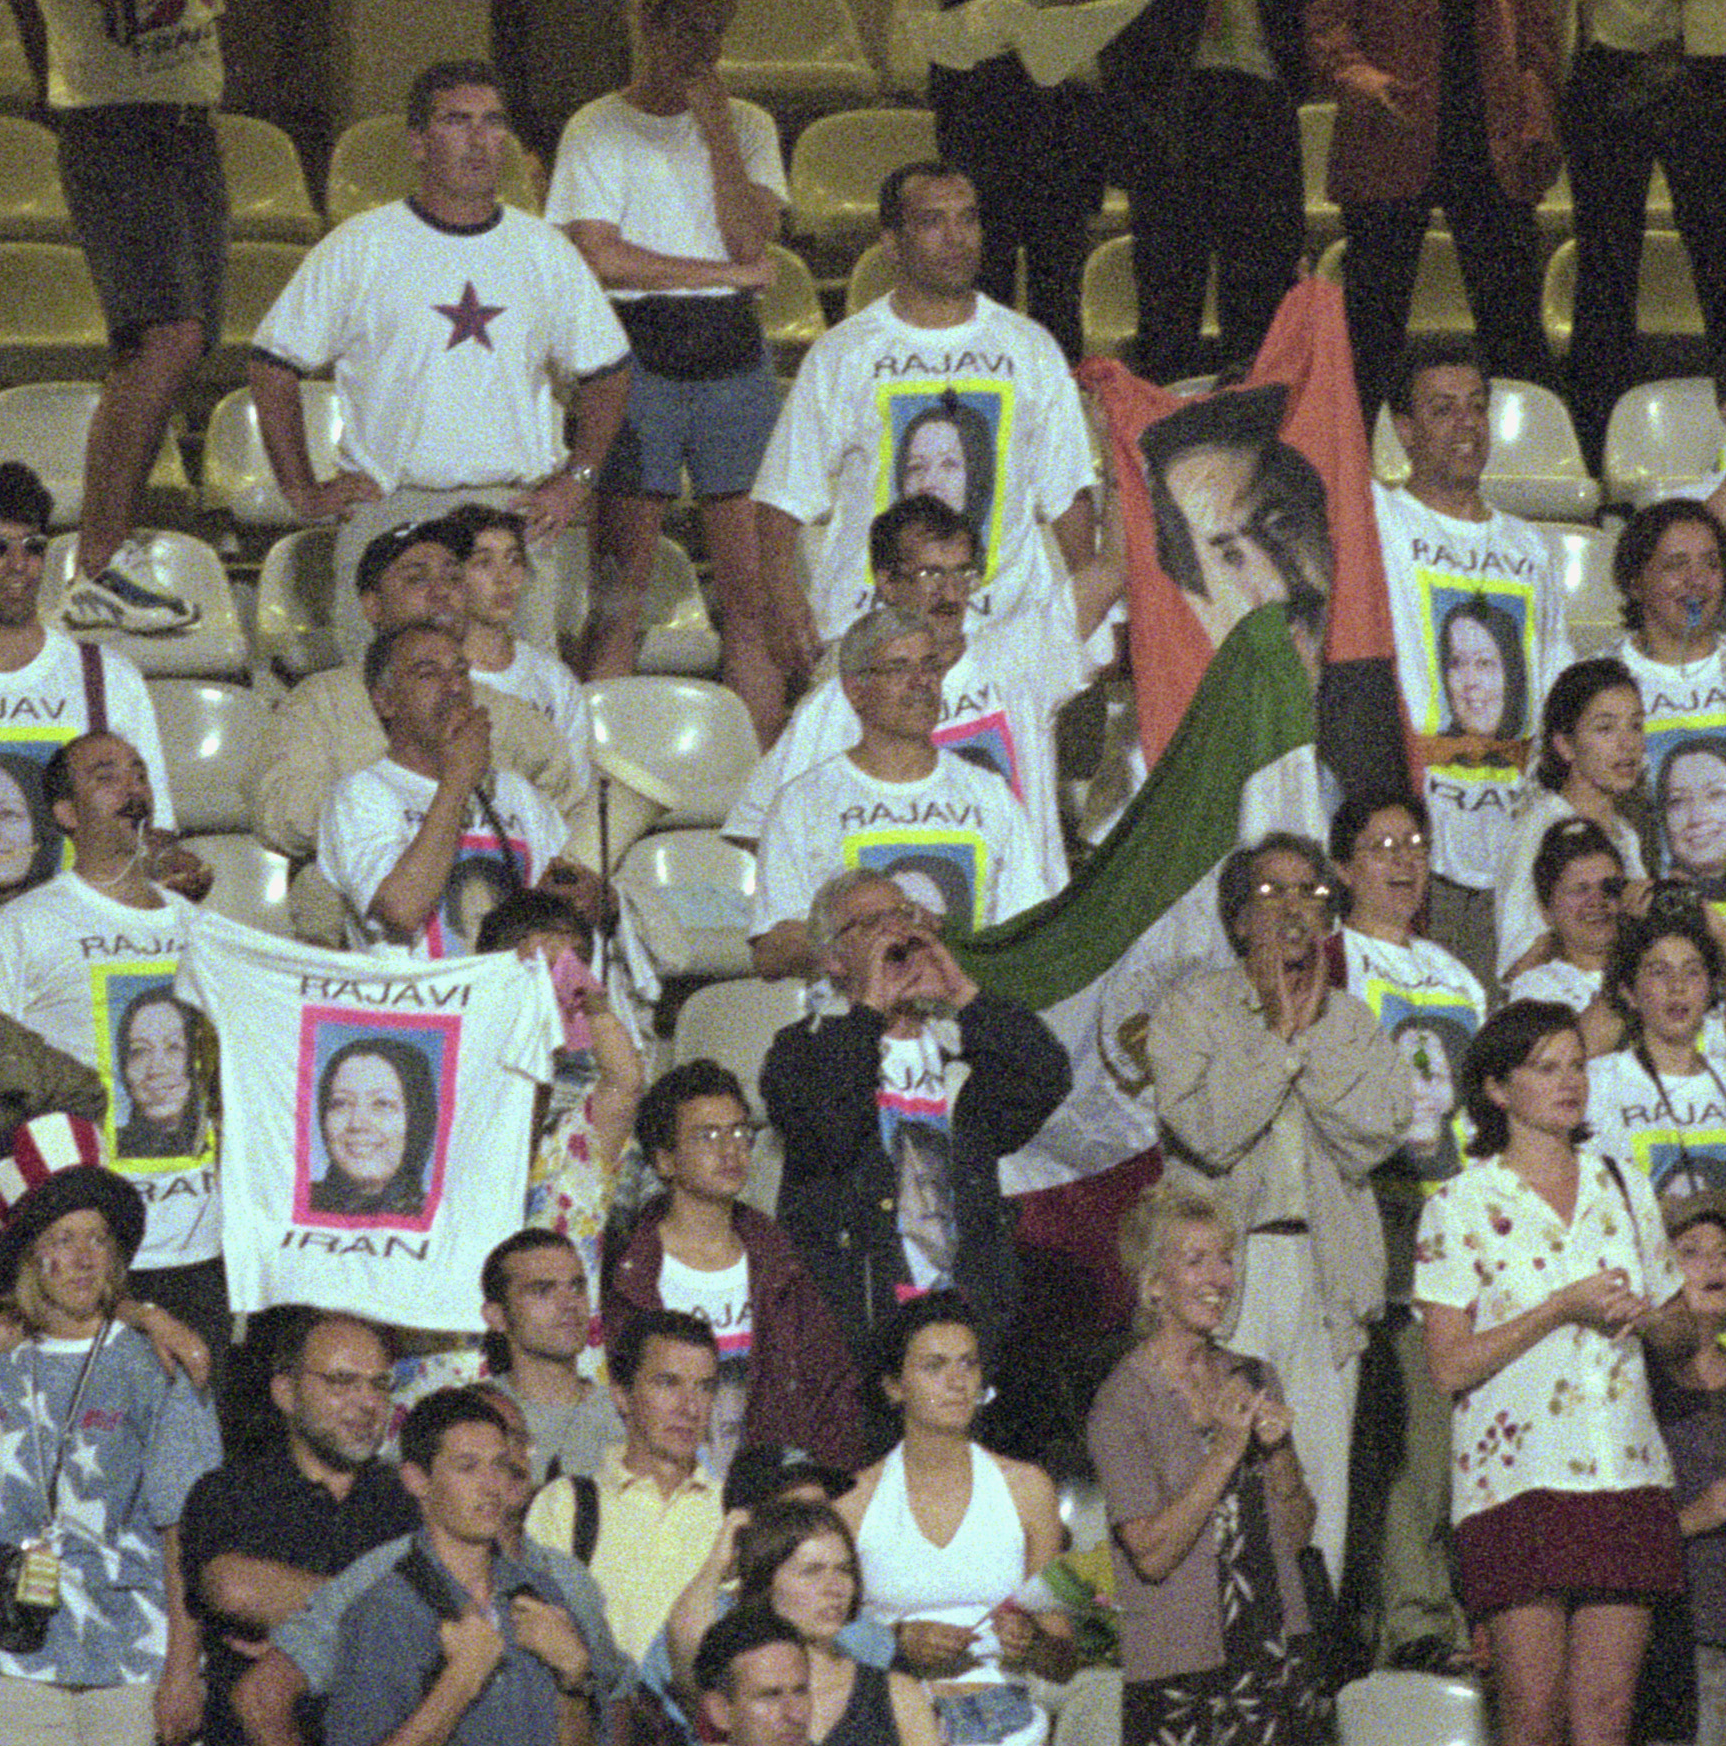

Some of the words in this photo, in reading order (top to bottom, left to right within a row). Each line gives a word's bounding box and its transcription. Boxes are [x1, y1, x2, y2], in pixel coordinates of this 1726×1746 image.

[873, 351, 1015, 378] RAJAVI
[1410, 537, 1536, 576] RAJAVI
[838, 800, 985, 831] RAJAVI
[299, 973, 472, 1008] RAJAVI
[280, 1231, 430, 1262] IRAN
